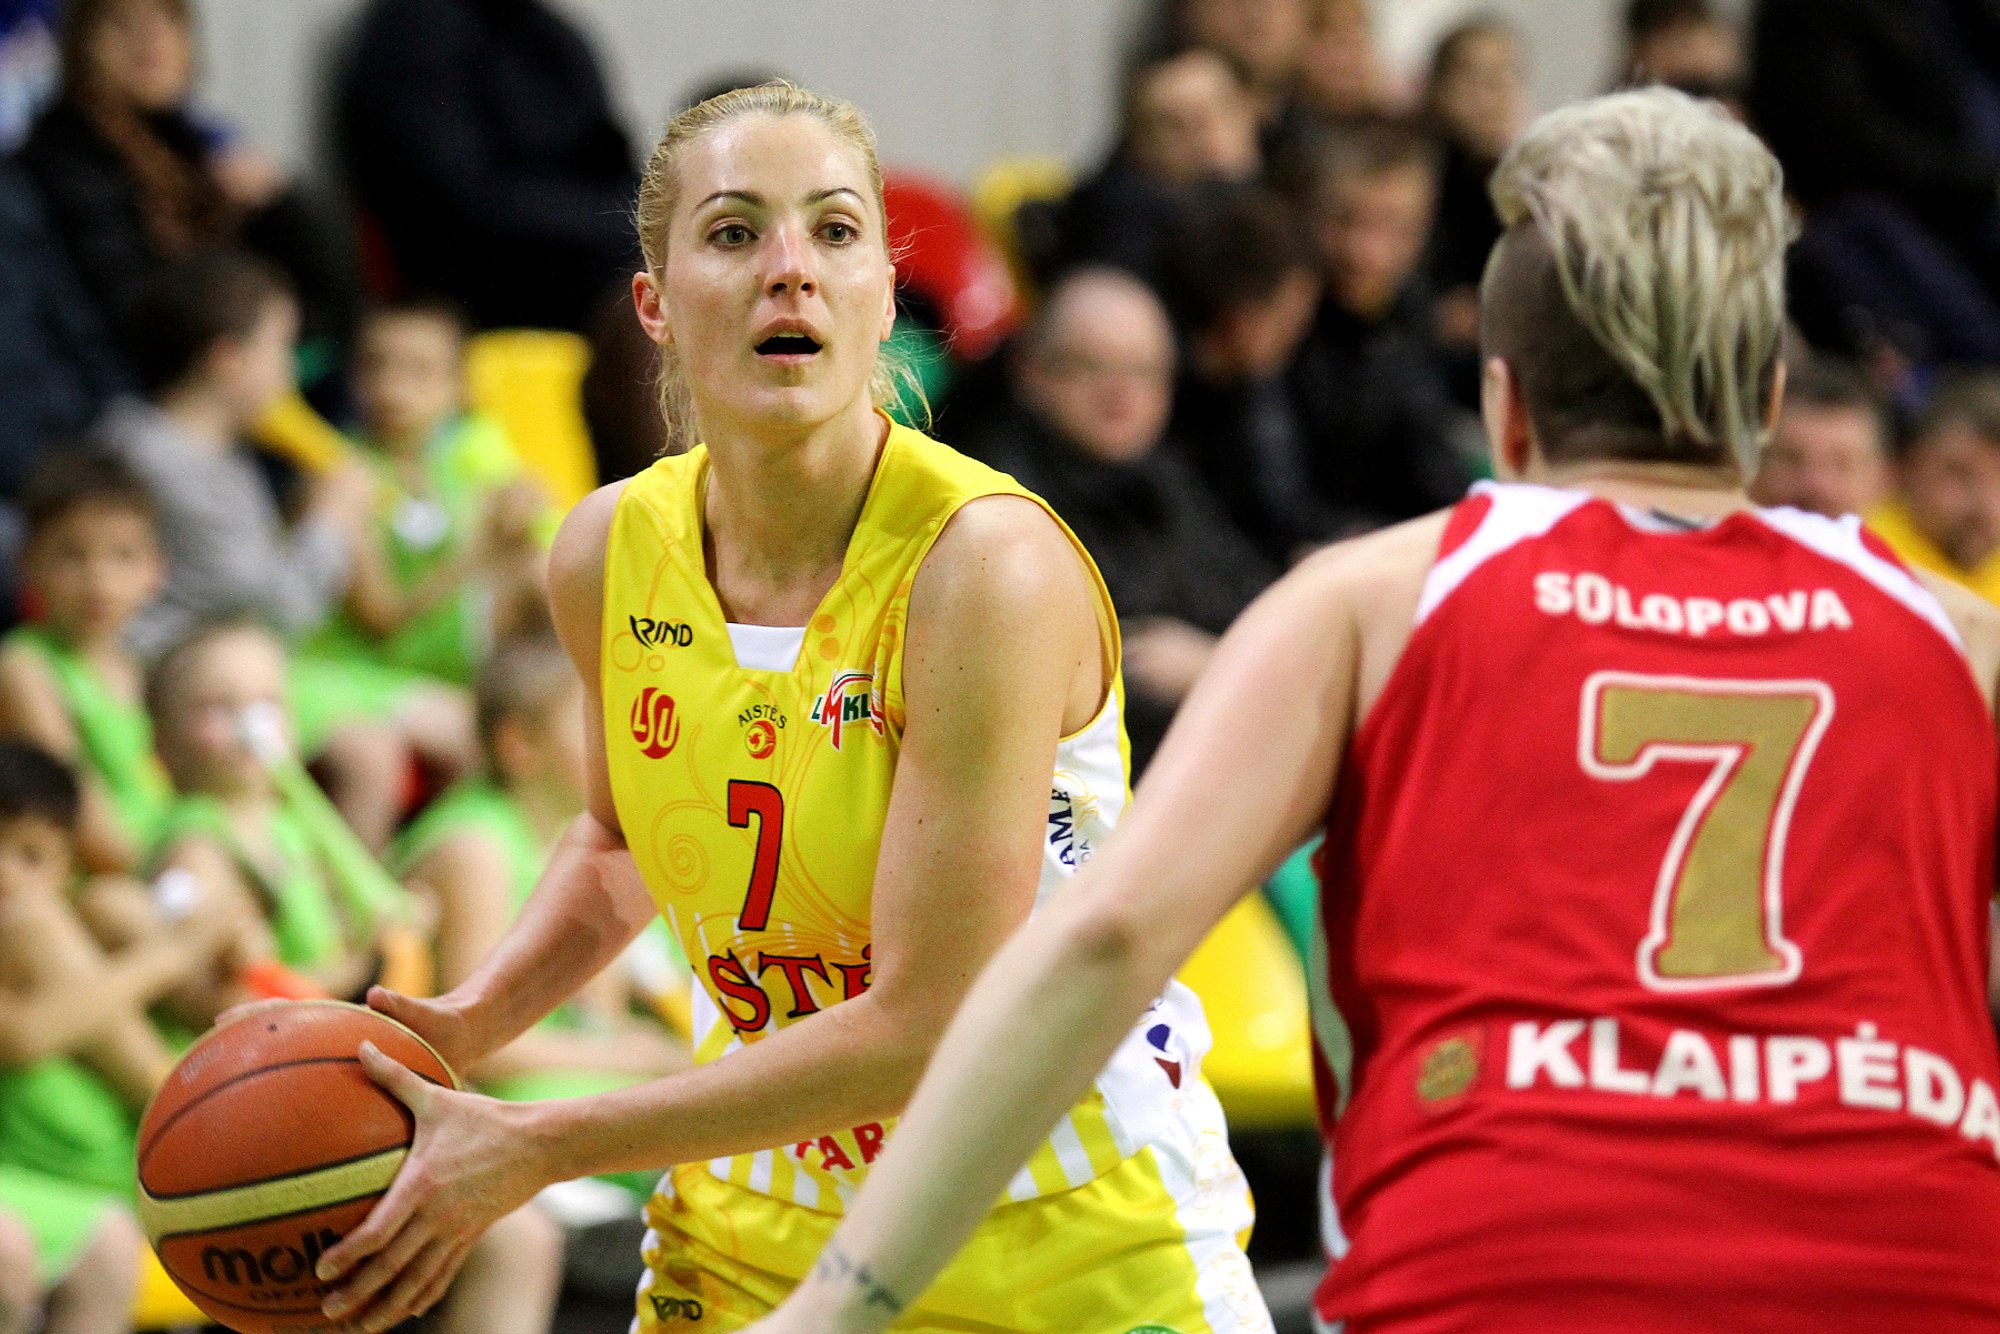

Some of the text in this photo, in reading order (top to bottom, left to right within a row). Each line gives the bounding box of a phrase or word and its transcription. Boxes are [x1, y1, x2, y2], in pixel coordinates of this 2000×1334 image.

[1533, 571, 1853, 638] SOLOPOVA
[738, 703, 788, 730] AISTĖS
[728, 779, 784, 931] 7
[1577, 670, 1837, 994] 7
[1506, 1018, 2000, 1162] KLAIPĖDA
